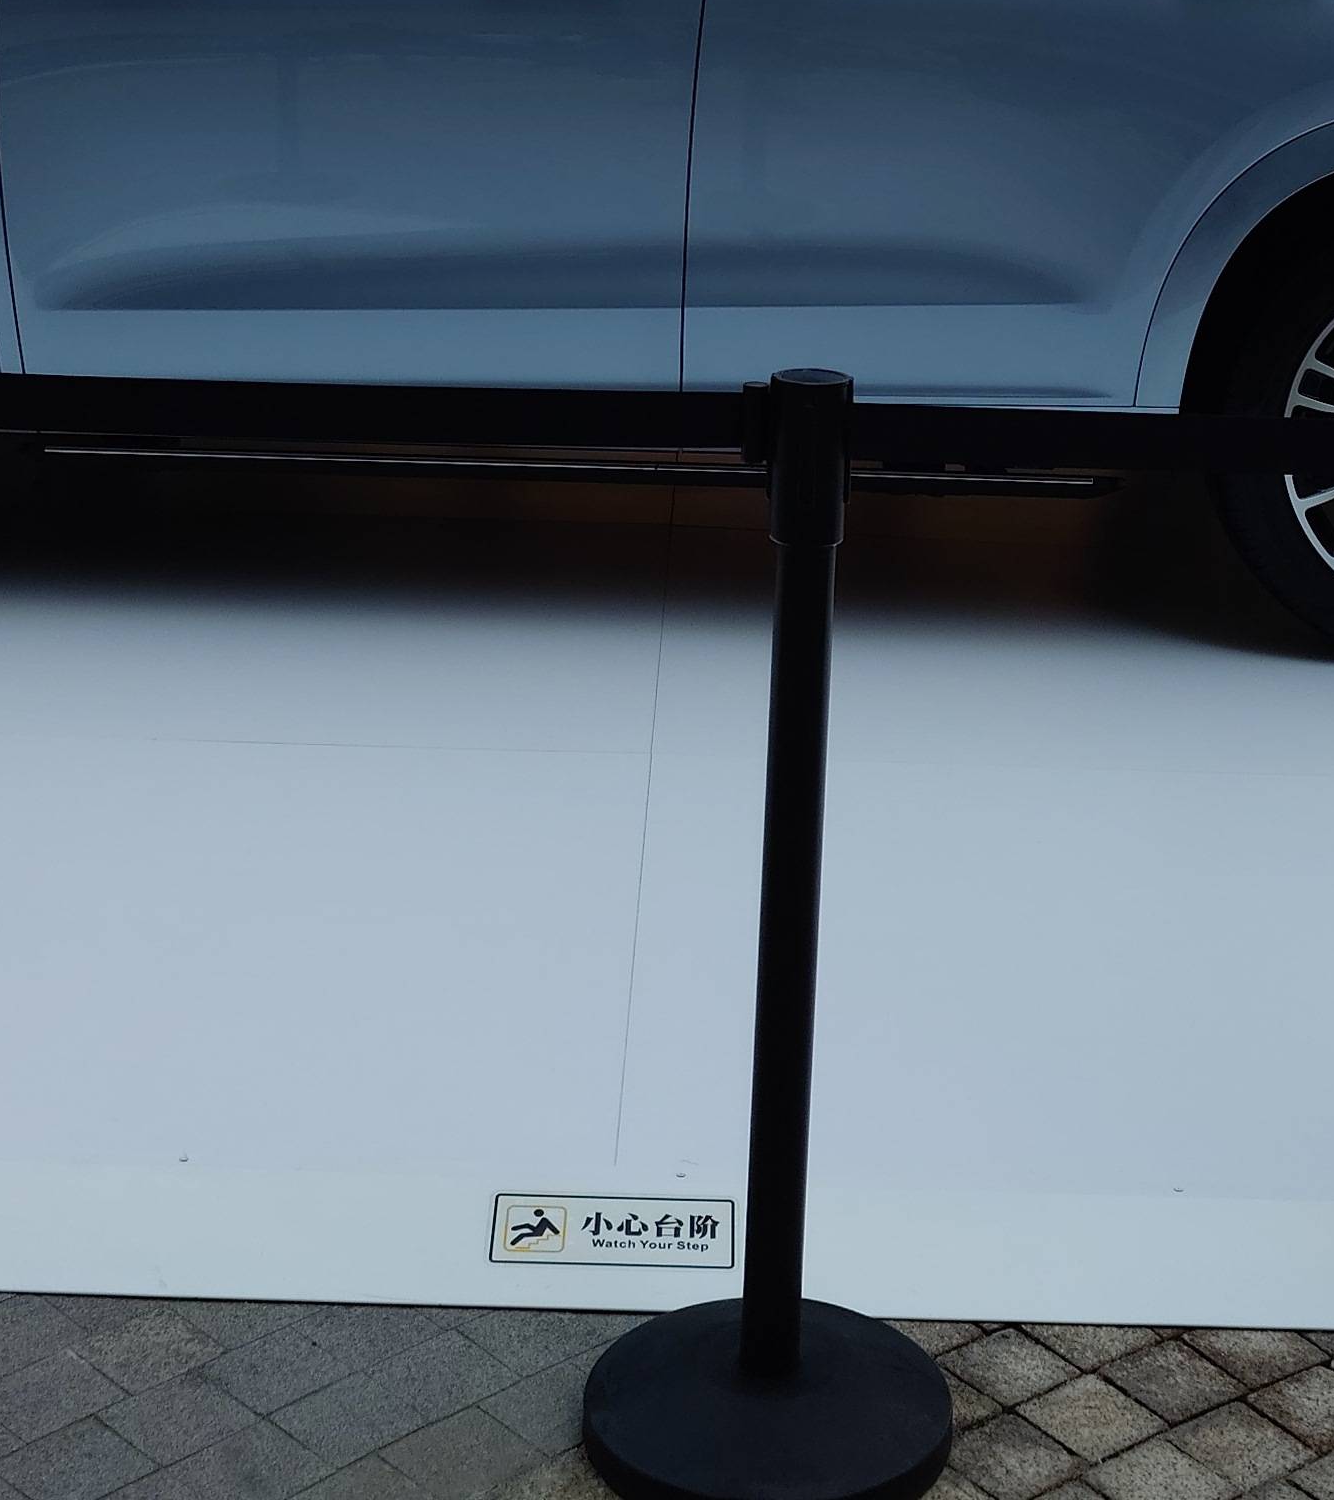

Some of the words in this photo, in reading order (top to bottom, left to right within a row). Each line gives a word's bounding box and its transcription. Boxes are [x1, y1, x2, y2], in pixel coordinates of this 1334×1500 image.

[581, 1212, 720, 1239] 小心台阶
[592, 1238, 636, 1249] Watch
[639, 1240, 673, 1251] Your
[677, 1241, 709, 1252] Step
